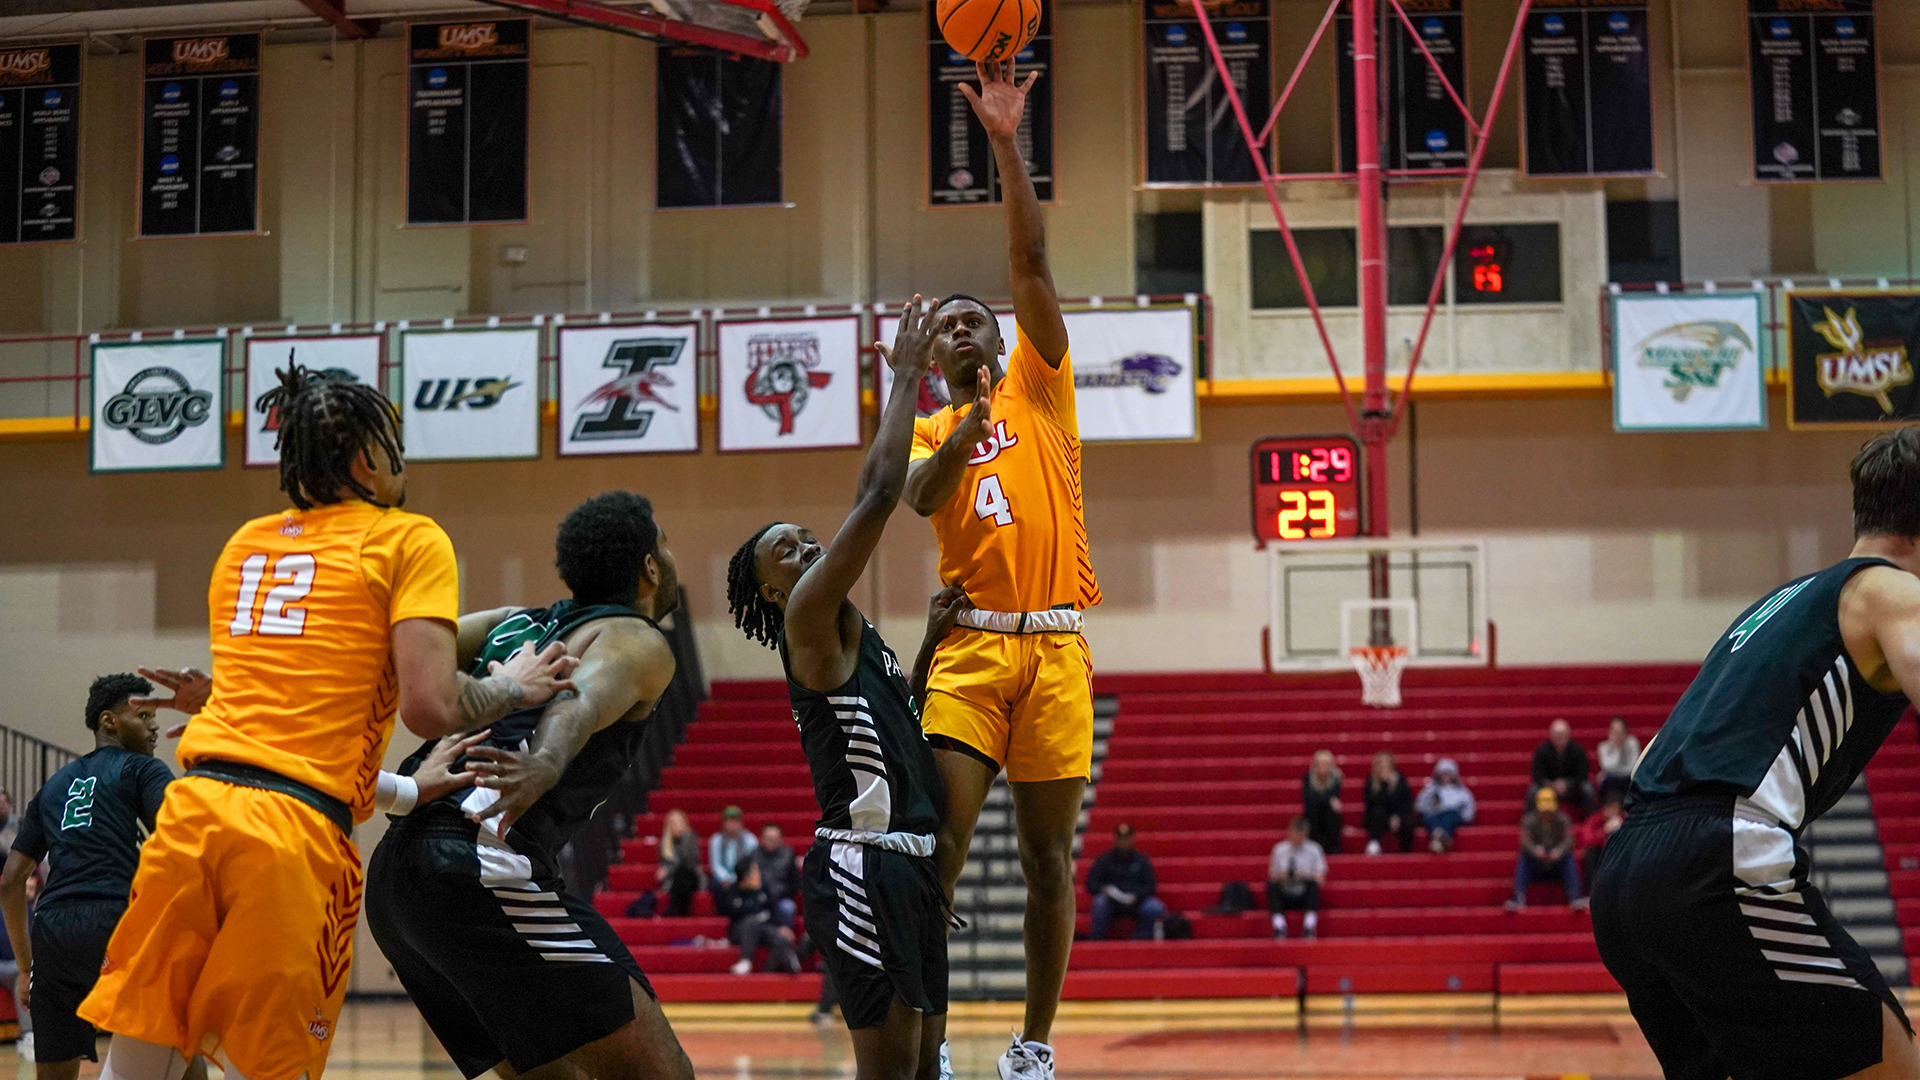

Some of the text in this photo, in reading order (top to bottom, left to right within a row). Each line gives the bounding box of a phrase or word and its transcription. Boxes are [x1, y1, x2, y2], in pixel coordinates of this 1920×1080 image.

[174, 40, 229, 63] UMSL
[440, 25, 498, 49] UMSL
[1819, 351, 1908, 392] UMSL
[103, 391, 212, 430] GLVC
[413, 378, 503, 411] UIS
[1269, 446, 1352, 483] 11:29
[974, 473, 1014, 527] 4
[1277, 489, 1336, 540] 23
[229, 552, 317, 638] 12
[60, 775, 97, 831] 2
